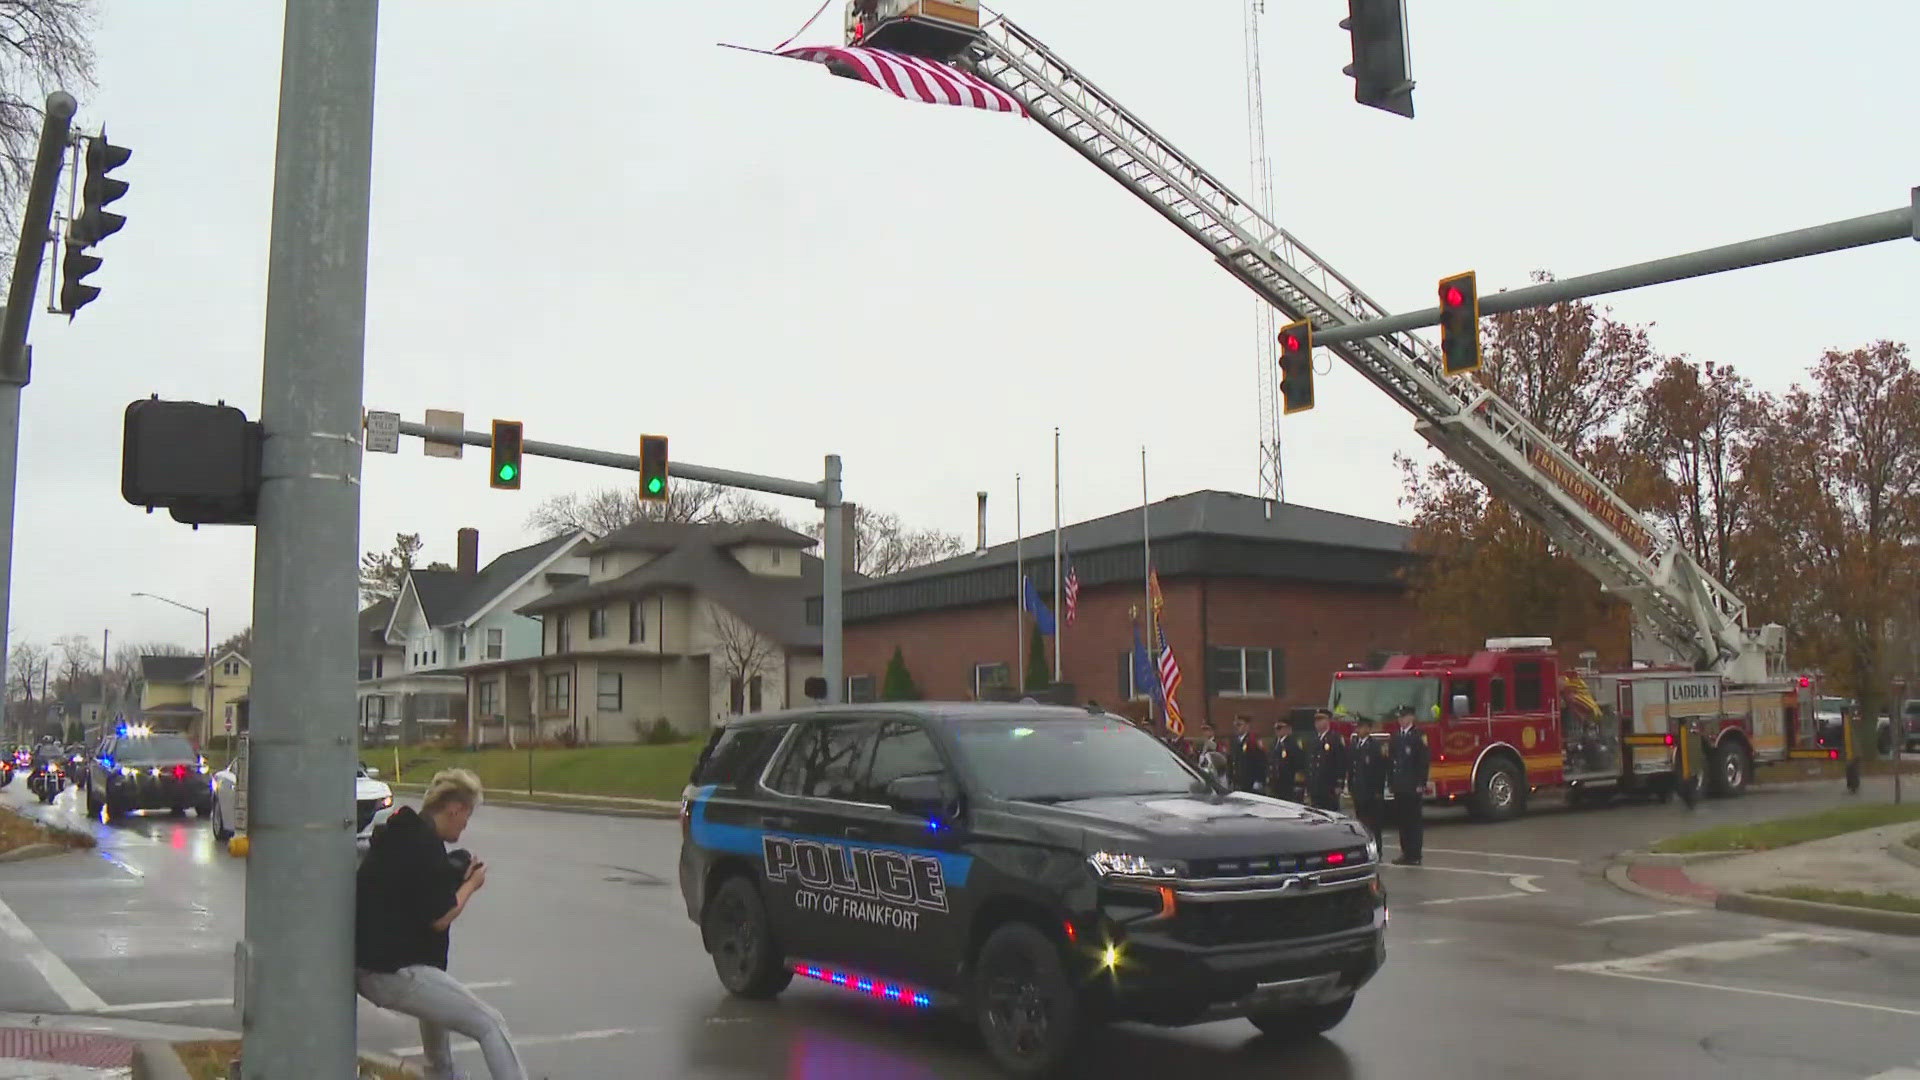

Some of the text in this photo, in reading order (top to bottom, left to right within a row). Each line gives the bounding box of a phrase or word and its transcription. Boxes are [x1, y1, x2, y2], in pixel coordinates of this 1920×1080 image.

[1535, 449, 1594, 505] FRANKFORT
[1597, 500, 1618, 524] FIRE
[1672, 684, 1716, 700] LADDER 1
[762, 835, 949, 913] POLICE
[795, 889, 919, 931] CITY OF FRANKFORT
